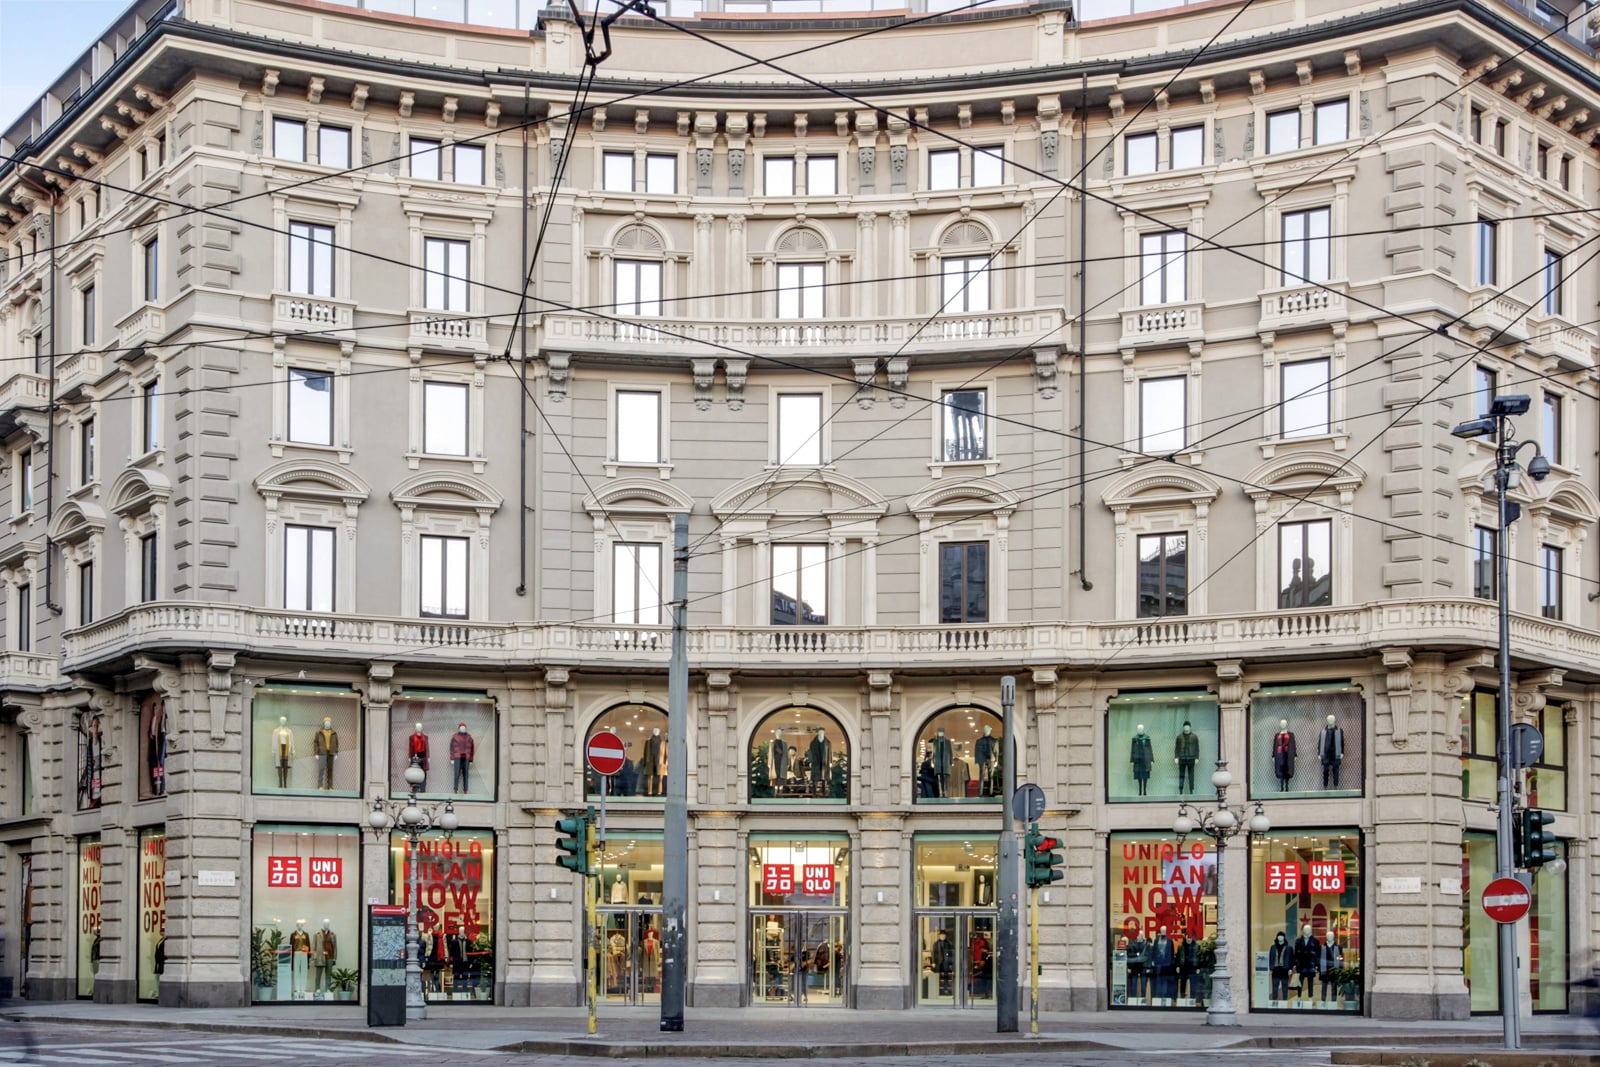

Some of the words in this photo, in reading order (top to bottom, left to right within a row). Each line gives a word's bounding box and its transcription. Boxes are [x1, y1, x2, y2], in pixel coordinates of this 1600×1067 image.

[144, 838, 166, 857] UNIQ
[1123, 843, 1204, 863] UNIQLO
[312, 861, 336, 872] UNI
[806, 867, 829, 878] UNI
[1123, 865, 1204, 884] MILAN
[1312, 865, 1338, 876] UNI
[312, 873, 339, 886] QLO
[806, 879, 831, 892] QLO
[1312, 878, 1341, 891] QLO
[1123, 887, 1204, 914] NOW
[144, 910, 166, 933] OPE
[1123, 916, 1204, 940] OPEN
